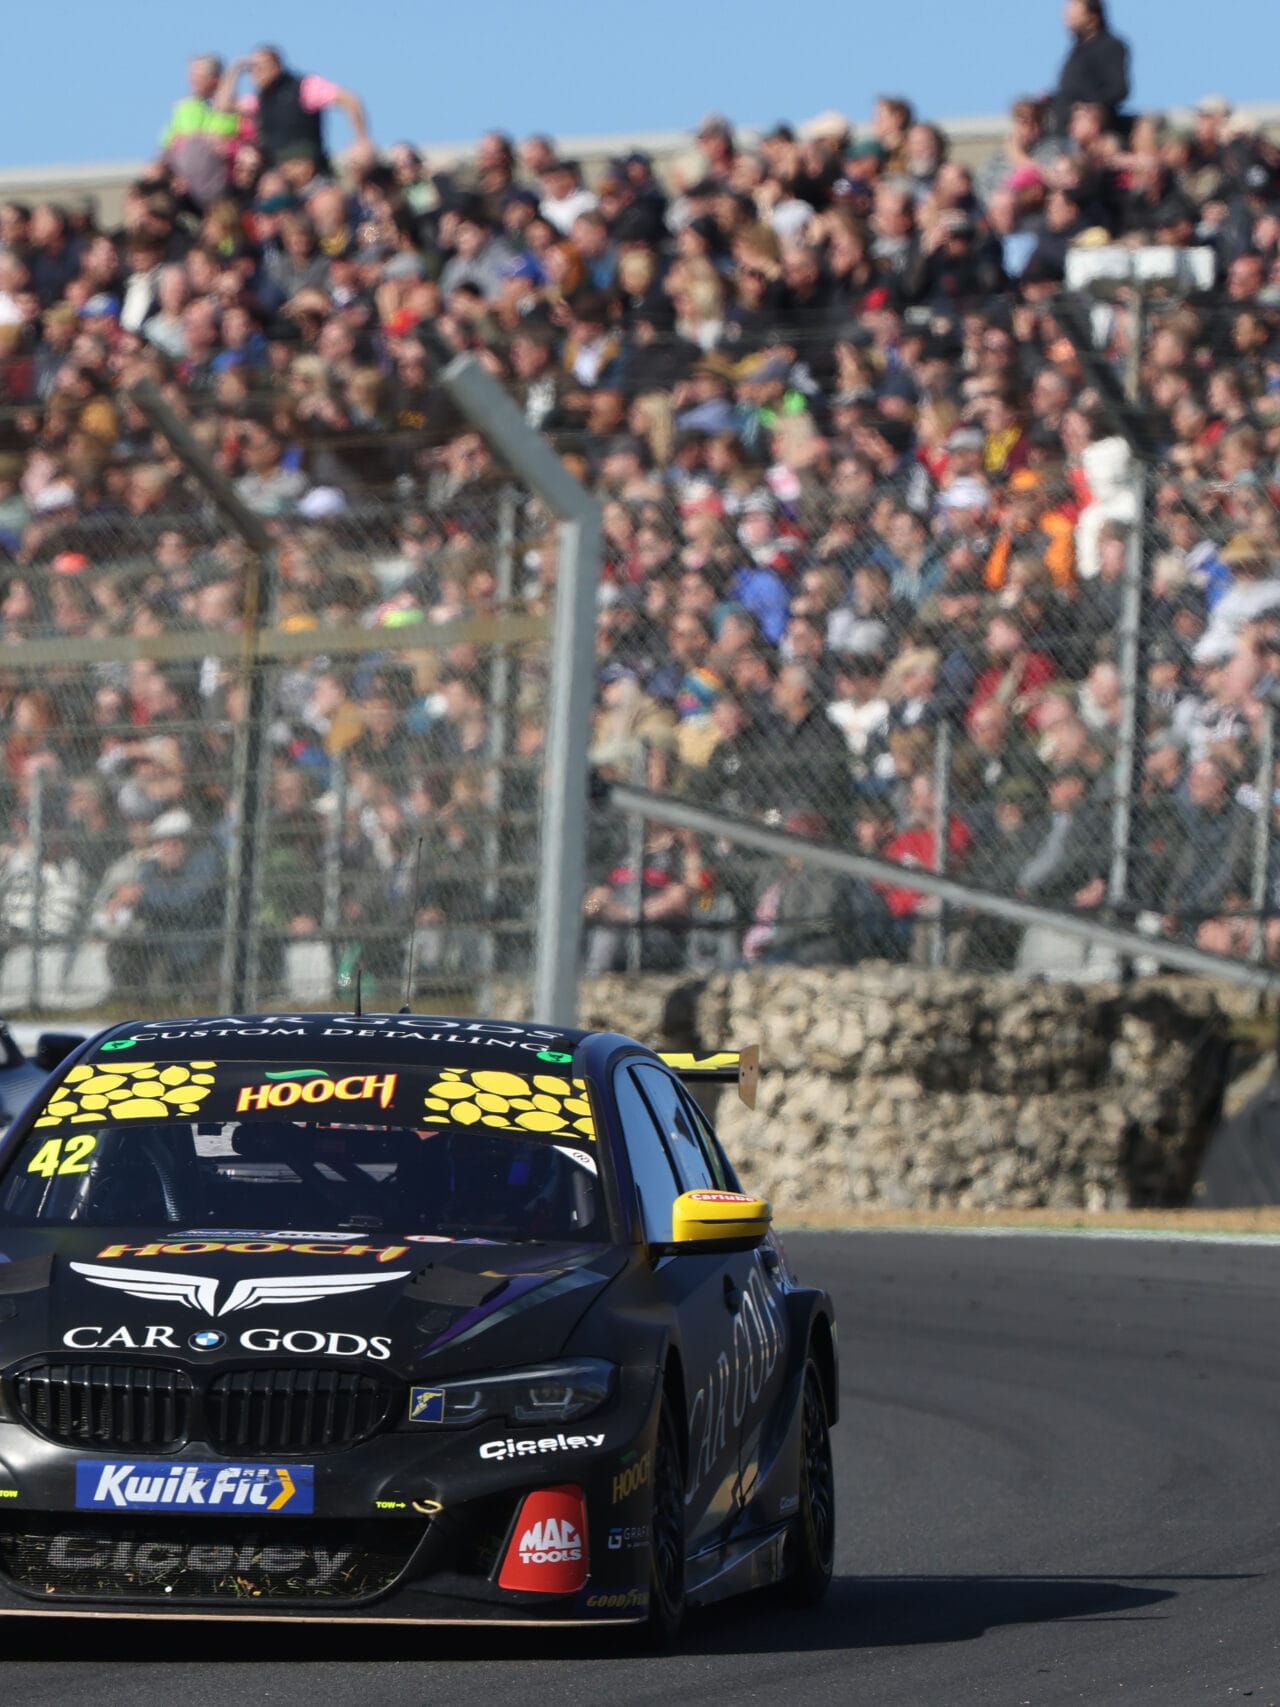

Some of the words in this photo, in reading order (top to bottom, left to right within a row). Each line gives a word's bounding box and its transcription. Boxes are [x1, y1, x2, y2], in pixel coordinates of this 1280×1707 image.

[130, 1028, 308, 1042] CUSTOM
[321, 1028, 551, 1053] DETAILING
[143, 1016, 314, 1028] CAR
[331, 1016, 564, 1040] GODS
[235, 1073, 398, 1113] HOOCH
[26, 1134, 98, 1178] 42
[96, 1241, 411, 1263] HOOCH
[62, 1325, 181, 1350] CAR
[239, 1328, 393, 1360] GODS
[480, 1434, 605, 1459] Ciceley
[376, 1501, 397, 1509] TOW
[519, 1518, 581, 1551] MAC
[47, 1535, 353, 1587] Ciceley
[519, 1549, 582, 1564] TOOLS
